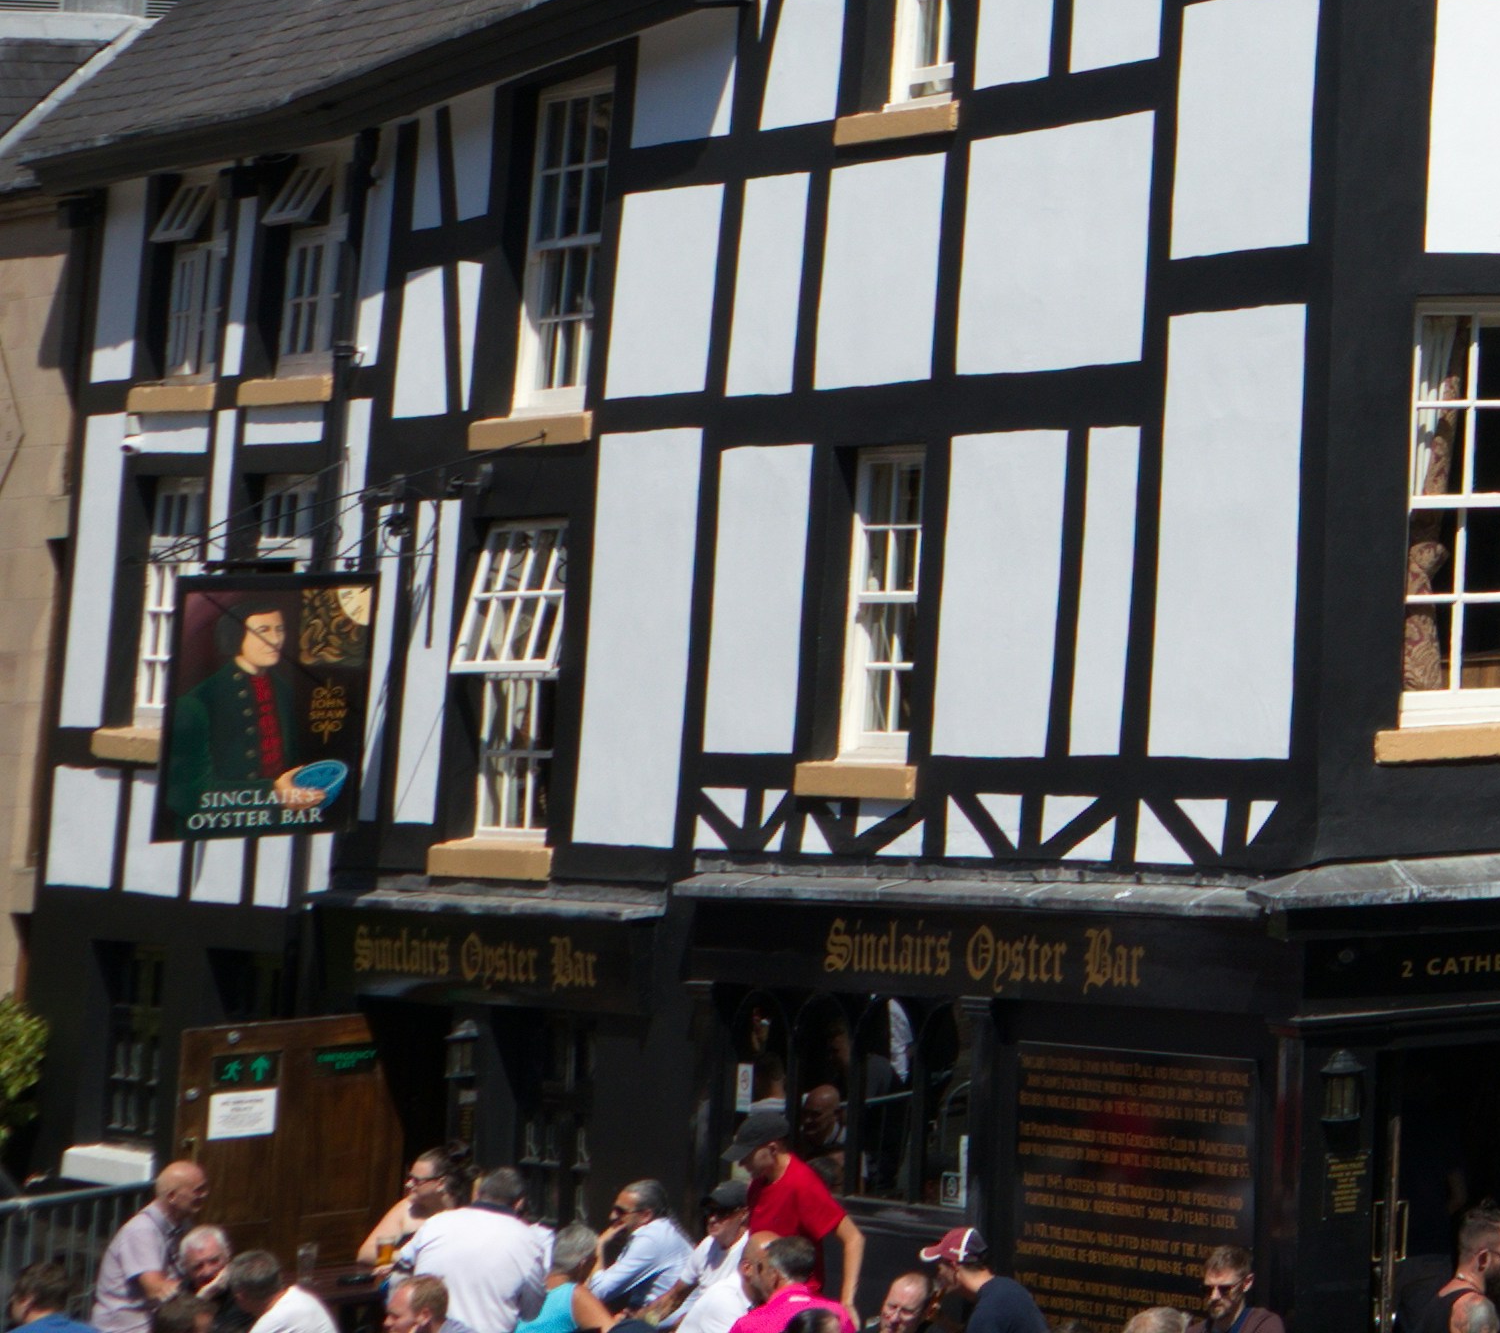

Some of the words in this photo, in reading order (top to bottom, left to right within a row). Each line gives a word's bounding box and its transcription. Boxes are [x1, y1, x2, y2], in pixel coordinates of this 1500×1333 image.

[187, 811, 272, 830] OYSTER
[281, 807, 324, 824] BAR
[353, 924, 449, 975] Sinclairs
[461, 932, 539, 990] Oyster
[550, 935, 597, 992] Bar
[824, 917, 952, 976] Sinclairs
[966, 924, 1067, 993] Oyster
[1083, 926, 1145, 994] Bar
[1401, 960, 1413, 977] 2
